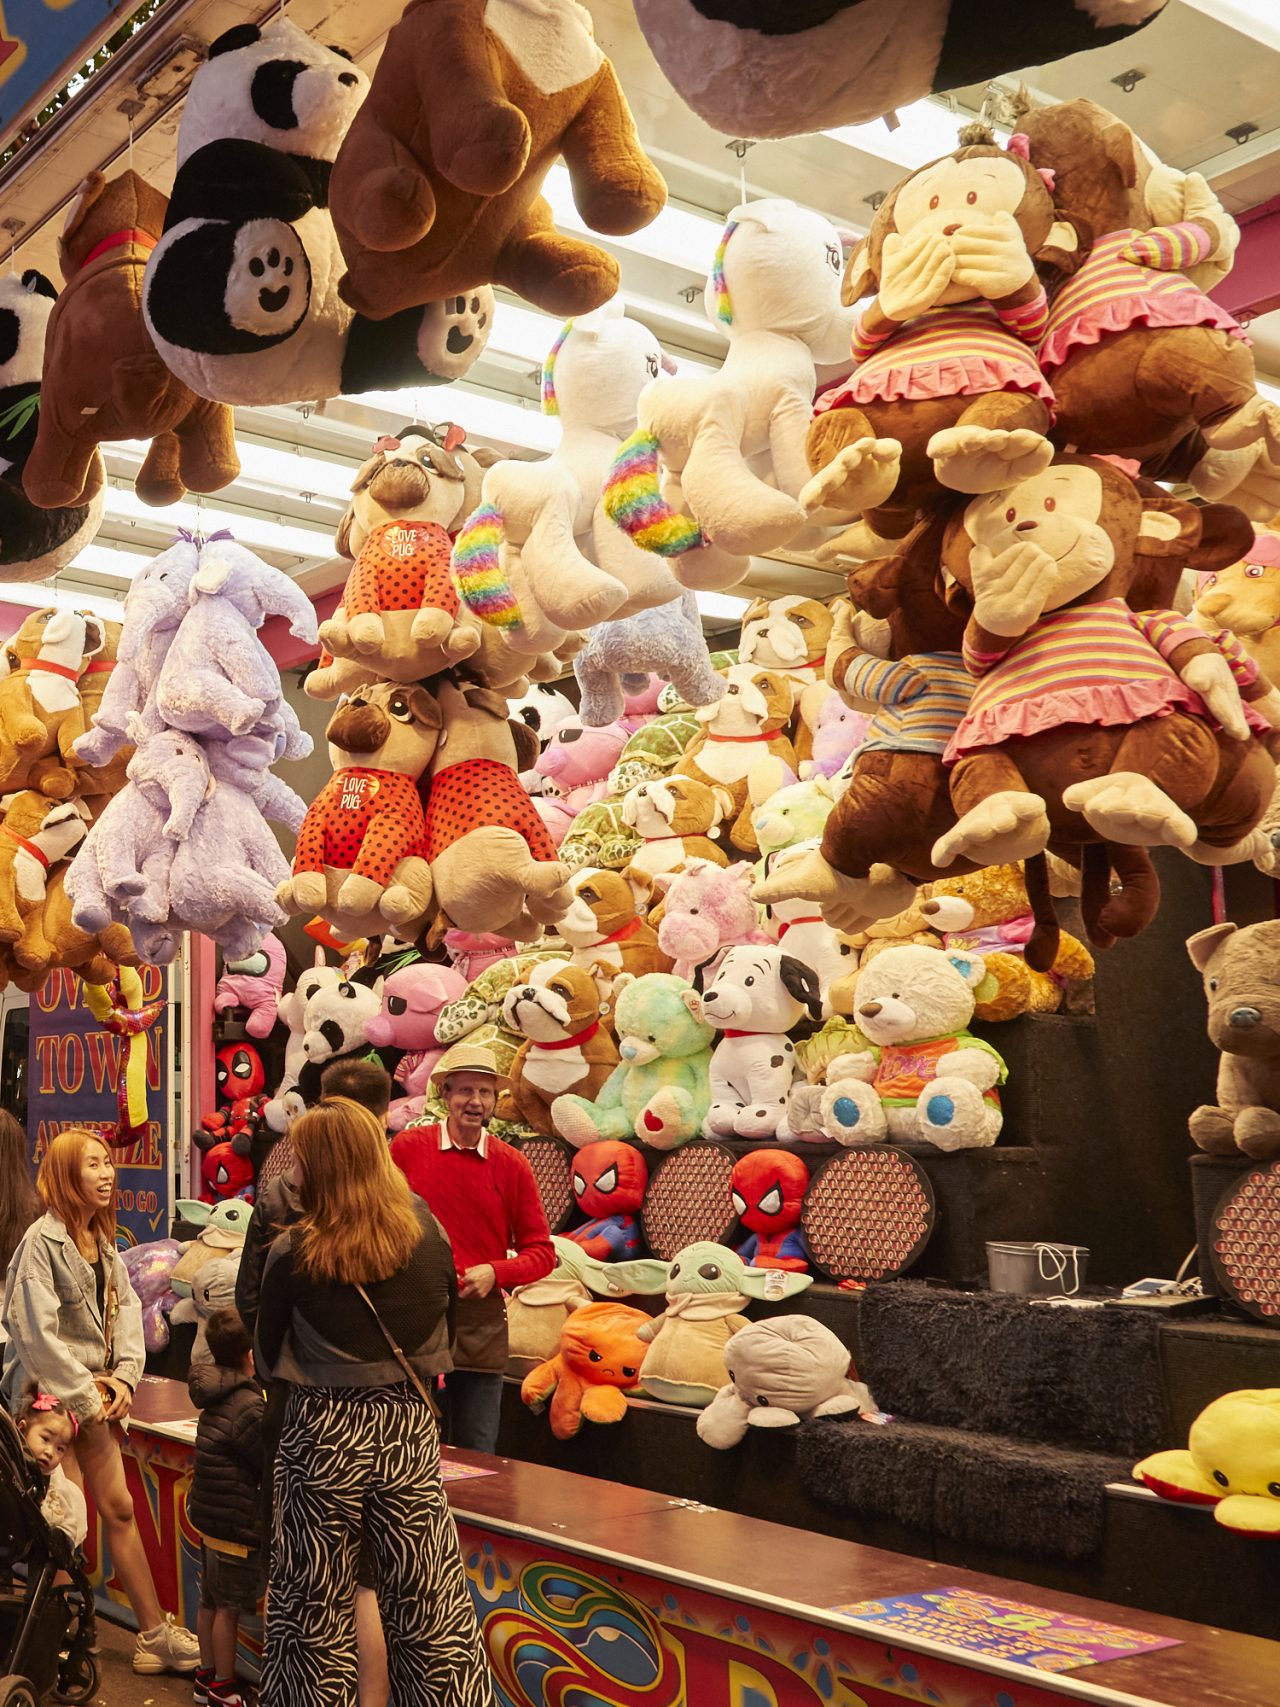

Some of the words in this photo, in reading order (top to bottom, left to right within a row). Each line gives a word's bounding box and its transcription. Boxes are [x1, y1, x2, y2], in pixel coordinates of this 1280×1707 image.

[391, 528, 417, 544] LOVE
[392, 543, 414, 557] PUG
[342, 777, 367, 793] LOVE
[340, 793, 362, 809] PUG
[135, 1190, 158, 1219] GO
